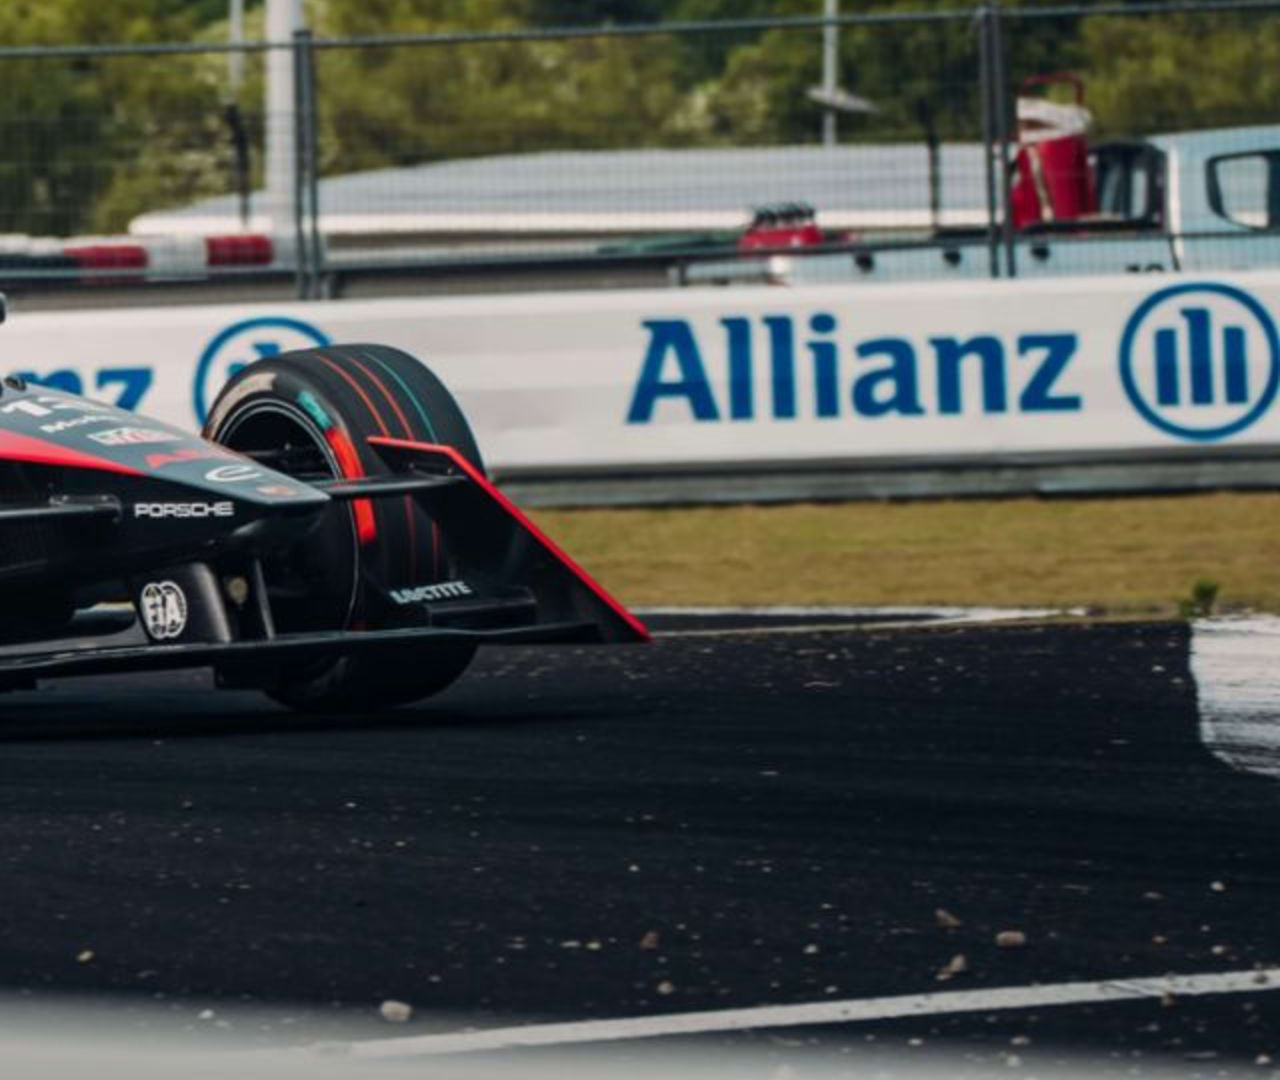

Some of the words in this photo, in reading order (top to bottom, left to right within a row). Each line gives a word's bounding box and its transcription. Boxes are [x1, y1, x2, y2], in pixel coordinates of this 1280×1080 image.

[626, 314, 1082, 424] Allianz
[134, 501, 235, 519] PORSCHE
[389, 581, 472, 604] LOCTITE
